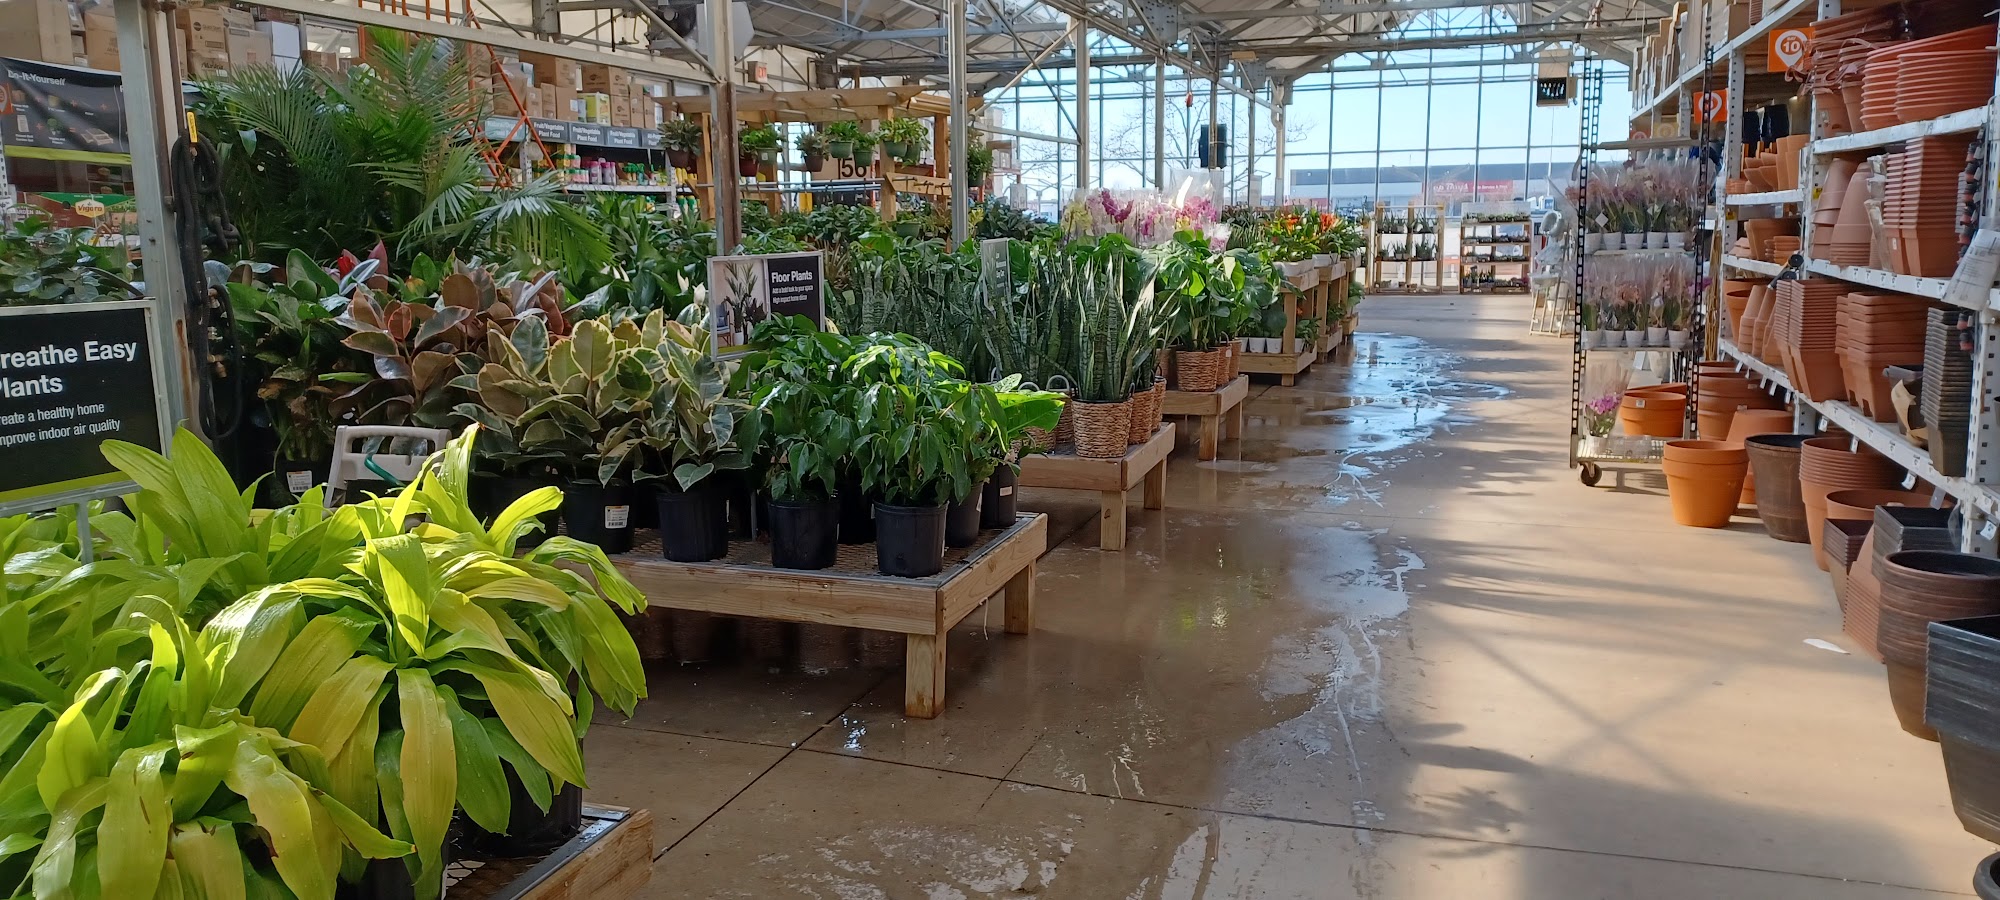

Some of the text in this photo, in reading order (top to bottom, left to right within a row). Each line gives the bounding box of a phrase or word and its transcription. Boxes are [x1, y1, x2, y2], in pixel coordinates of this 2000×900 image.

[1783, 41, 1800, 52] 10
[8, 70, 66, 86] Do-It-Yourself
[771, 270, 813, 283] Floor Plants
[0, 340, 137, 369] reathe Easy
[28, 411, 35, 422] a
[37, 405, 75, 421] healthy
[77, 402, 105, 416] home
[39, 424, 71, 441] indoor
[73, 422, 87, 435] air
[89, 418, 121, 434] quality
